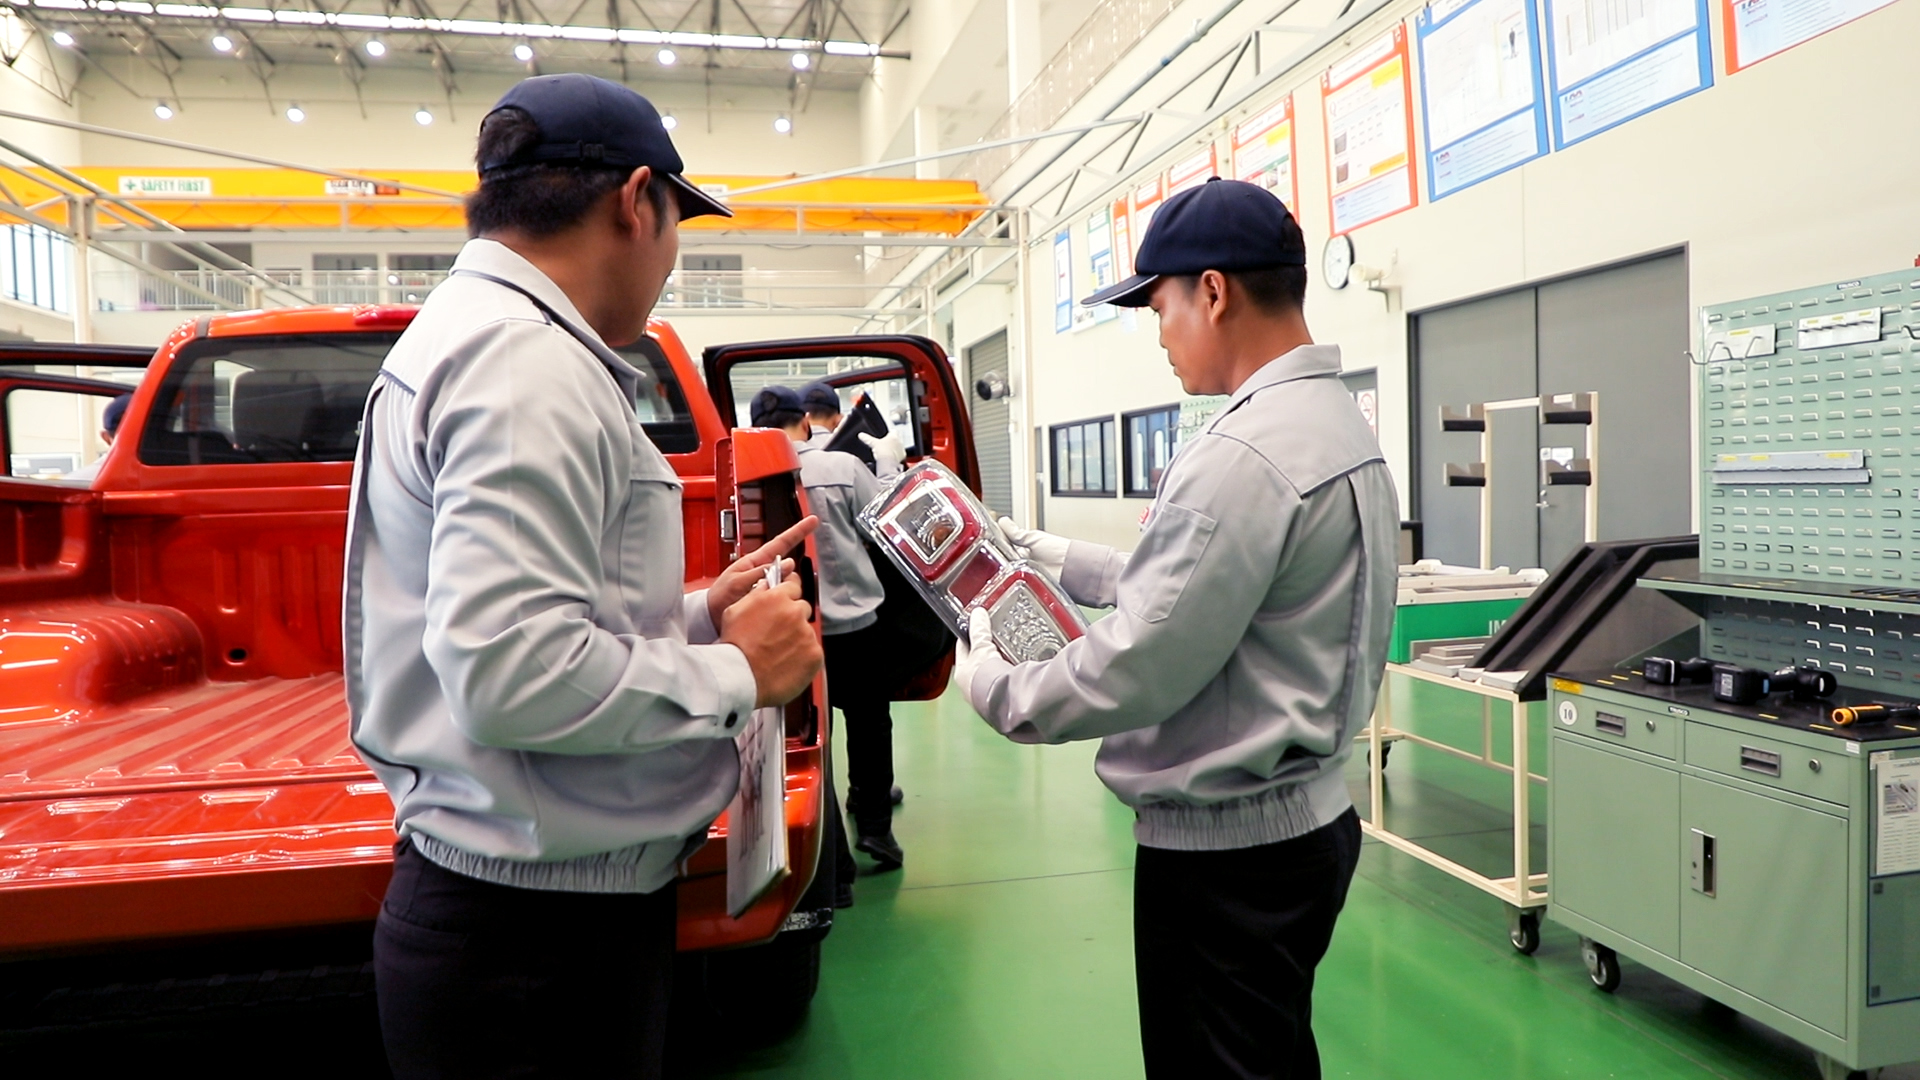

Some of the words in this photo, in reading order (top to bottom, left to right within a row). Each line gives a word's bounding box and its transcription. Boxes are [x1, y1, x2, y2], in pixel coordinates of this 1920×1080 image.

[141, 179, 175, 191] SAFETY
[178, 180, 204, 191] FIRST
[1563, 709, 1573, 720] 10
